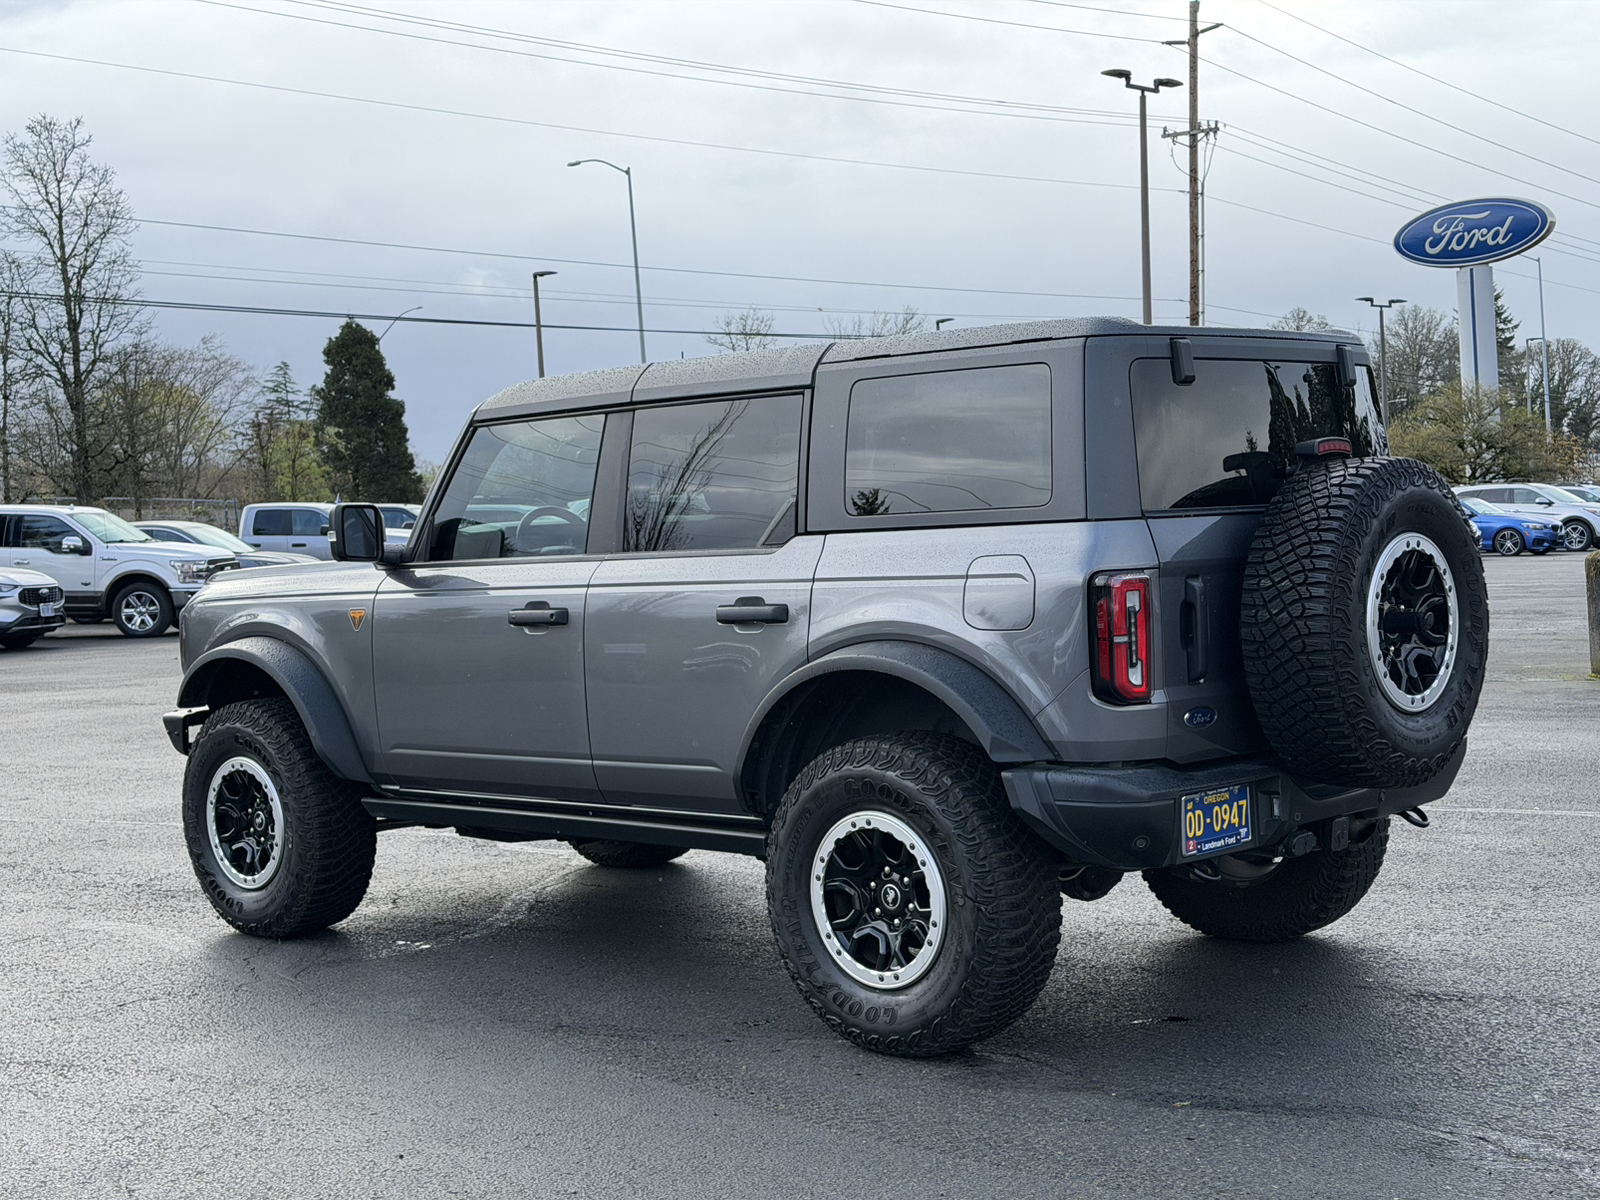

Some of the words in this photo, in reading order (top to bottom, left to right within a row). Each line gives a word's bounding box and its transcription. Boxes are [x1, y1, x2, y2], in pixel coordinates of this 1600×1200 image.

[1424, 210, 1514, 255] Ford
[1192, 712, 1211, 724] Ford
[1203, 792, 1231, 805] OREGON
[844, 777, 968, 908] GOODYEAR
[1202, 838, 1225, 851] Landmark
[1225, 834, 1237, 845] Ford
[781, 896, 899, 1026] GOODYEAR
